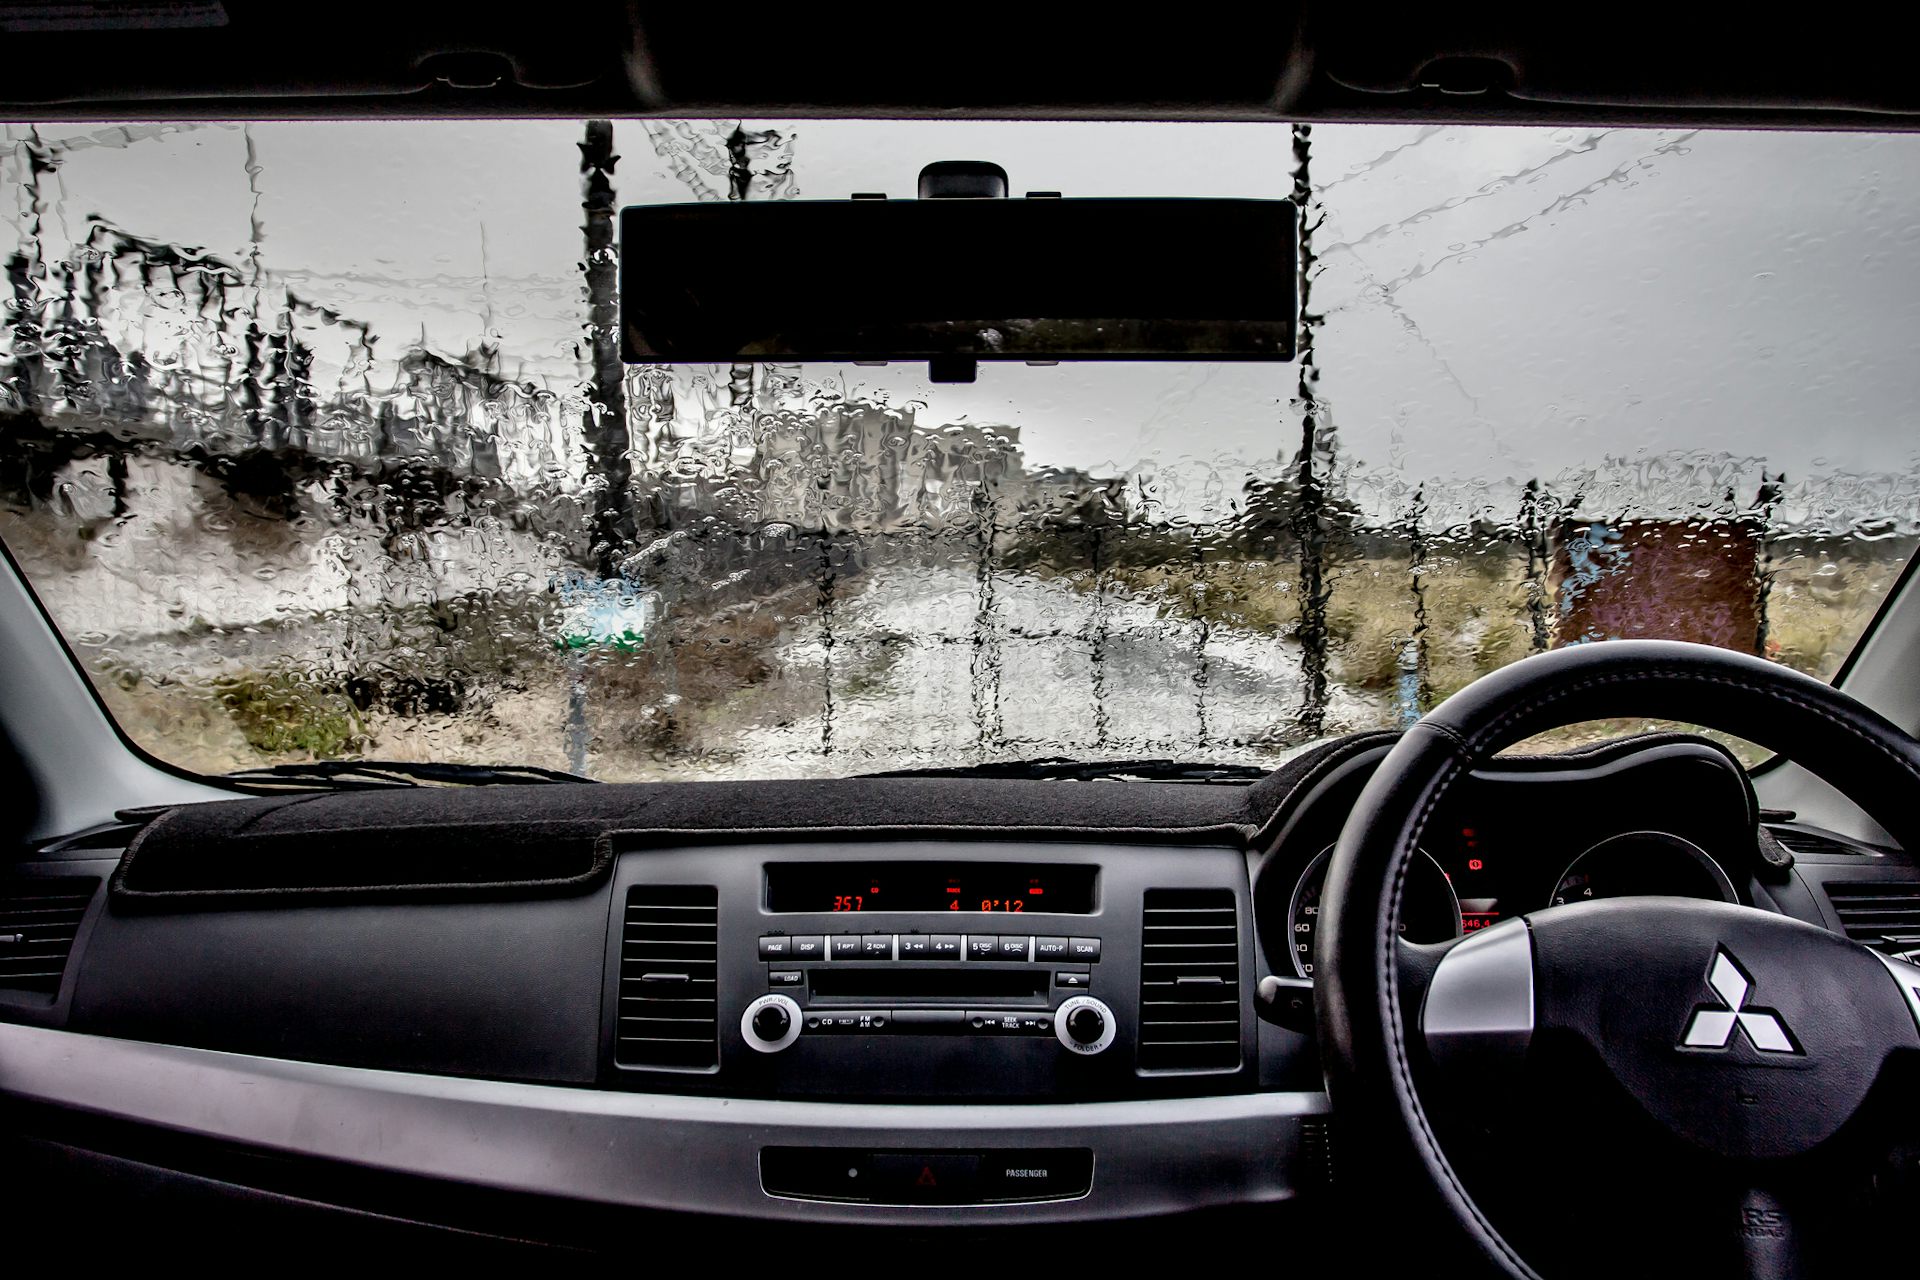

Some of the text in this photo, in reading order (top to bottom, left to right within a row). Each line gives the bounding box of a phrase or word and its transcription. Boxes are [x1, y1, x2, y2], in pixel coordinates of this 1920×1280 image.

[1583, 887, 1593, 897] 4
[1556, 896, 1565, 904] 3
[949, 899, 960, 911] 4
[1294, 923, 1310, 932] 60
[800, 943, 814, 951] DISP
[866, 942, 872, 950] 2
[905, 942, 911, 950] 3
[936, 942, 942, 950] 4
[972, 943, 978, 951] 5
[1004, 943, 1010, 951] 6
[1076, 945, 1093, 953] SCAN
[1005, 1168, 1048, 1178] PASSENGER
